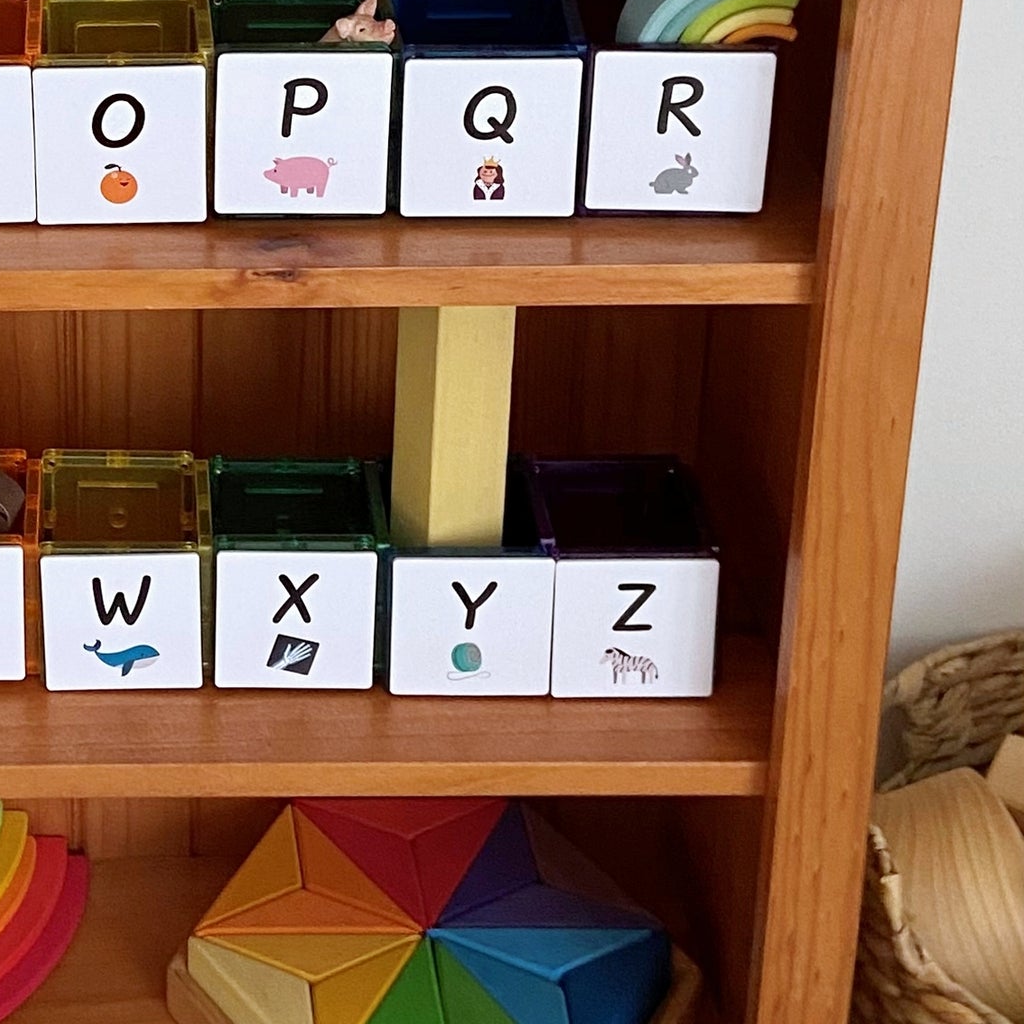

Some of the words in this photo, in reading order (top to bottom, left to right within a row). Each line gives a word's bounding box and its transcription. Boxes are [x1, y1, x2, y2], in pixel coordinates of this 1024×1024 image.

[91, 93, 146, 149] O
[281, 77, 329, 138] P
[463, 85, 517, 145] Q
[656, 75, 705, 137] R
[91, 574, 152, 626] W
[272, 573, 320, 624] X
[451, 581, 498, 630] Y
[611, 583, 657, 632] Z
